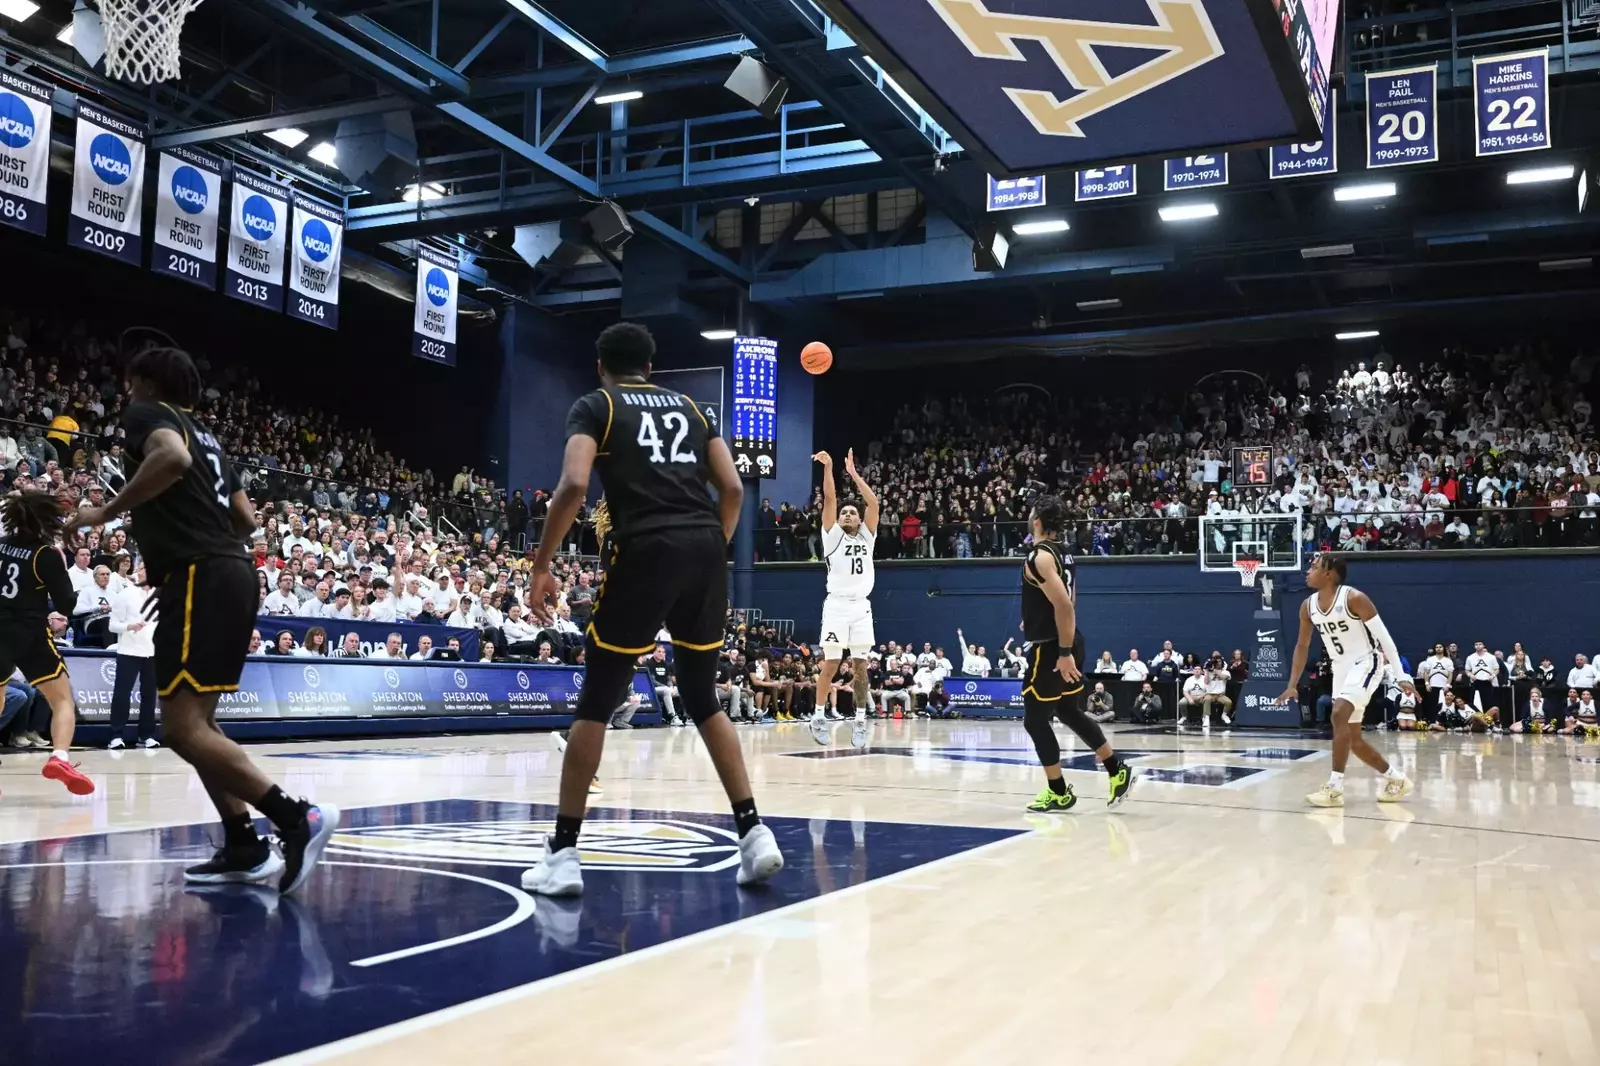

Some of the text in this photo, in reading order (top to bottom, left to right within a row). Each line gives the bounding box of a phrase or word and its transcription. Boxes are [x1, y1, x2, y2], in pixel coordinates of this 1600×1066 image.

[1499, 63, 1523, 75] MIKE
[1392, 79, 1410, 89] LEN
[1489, 71, 1533, 85] HARKINS
[2, 74, 50, 99] BASKETBALL
[1389, 88, 1414, 98] PAUL
[1502, 83, 1539, 92] BASKETBALL
[1393, 97, 1427, 106] BASKETBALL
[1487, 96, 1537, 132] 22
[80, 106, 144, 139] MEN'S BASKETBALL
[1378, 110, 1426, 144] 20
[1481, 132, 1545, 148] 1951, 1954-56
[183, 150, 220, 170] BASKETBALL
[1376, 146, 1428, 160] 1969-1973
[0, 153, 26, 172] IRST
[93, 153, 130, 177] NCAA
[1278, 157, 1328, 170] 1944-1947
[1172, 170, 1220, 183] 1970-1974
[235, 171, 287, 199] MEN'S BASKETBALL
[1082, 180, 1130, 194] 1998-2001
[93, 188, 124, 208] FIRST
[175, 185, 207, 207] NCAA
[993, 191, 1040, 204] 1984-1988
[0, 196, 27, 220] 86
[88, 201, 125, 223] ROUND
[315, 206, 343, 222] BASKETBALL
[174, 218, 201, 236] FIRST
[245, 213, 275, 233] NCAA
[84, 227, 126, 253] 2009
[170, 230, 203, 250] ROUND
[304, 236, 331, 255] NCAA
[243, 244, 269, 261] FIRST
[169, 255, 200, 278] 2011
[239, 258, 270, 274] ROUND
[303, 265, 325, 280] FIRST
[237, 279, 268, 301] 2013
[300, 276, 326, 294] ROUND
[427, 283, 449, 298] NCAA
[299, 298, 324, 319] 2014
[427, 310, 445, 323] FIRST
[424, 320, 445, 335] ROUND
[421, 339, 445, 358] 2022
[734, 337, 777, 348] PLAYER STATS
[737, 345, 775, 355] AKRON
[622, 393, 683, 407] HORNBEAK
[637, 411, 697, 464] 42
[739, 465, 770, 475] 41 34
[1249, 463, 1266, 483] 15
[207, 453, 230, 508] 2
[851, 558, 863, 575] 13
[1316, 621, 1349, 635] ZIPS
[825, 632, 839, 643] A
[1331, 637, 1344, 656] 5
[1433, 662, 1445, 670] A
[1475, 659, 1488, 667] A
[288, 691, 347, 703] SHERATON
[372, 692, 423, 702] SHERATON
[442, 692, 489, 702] SHERATON
[508, 692, 548, 702] SHERATON
